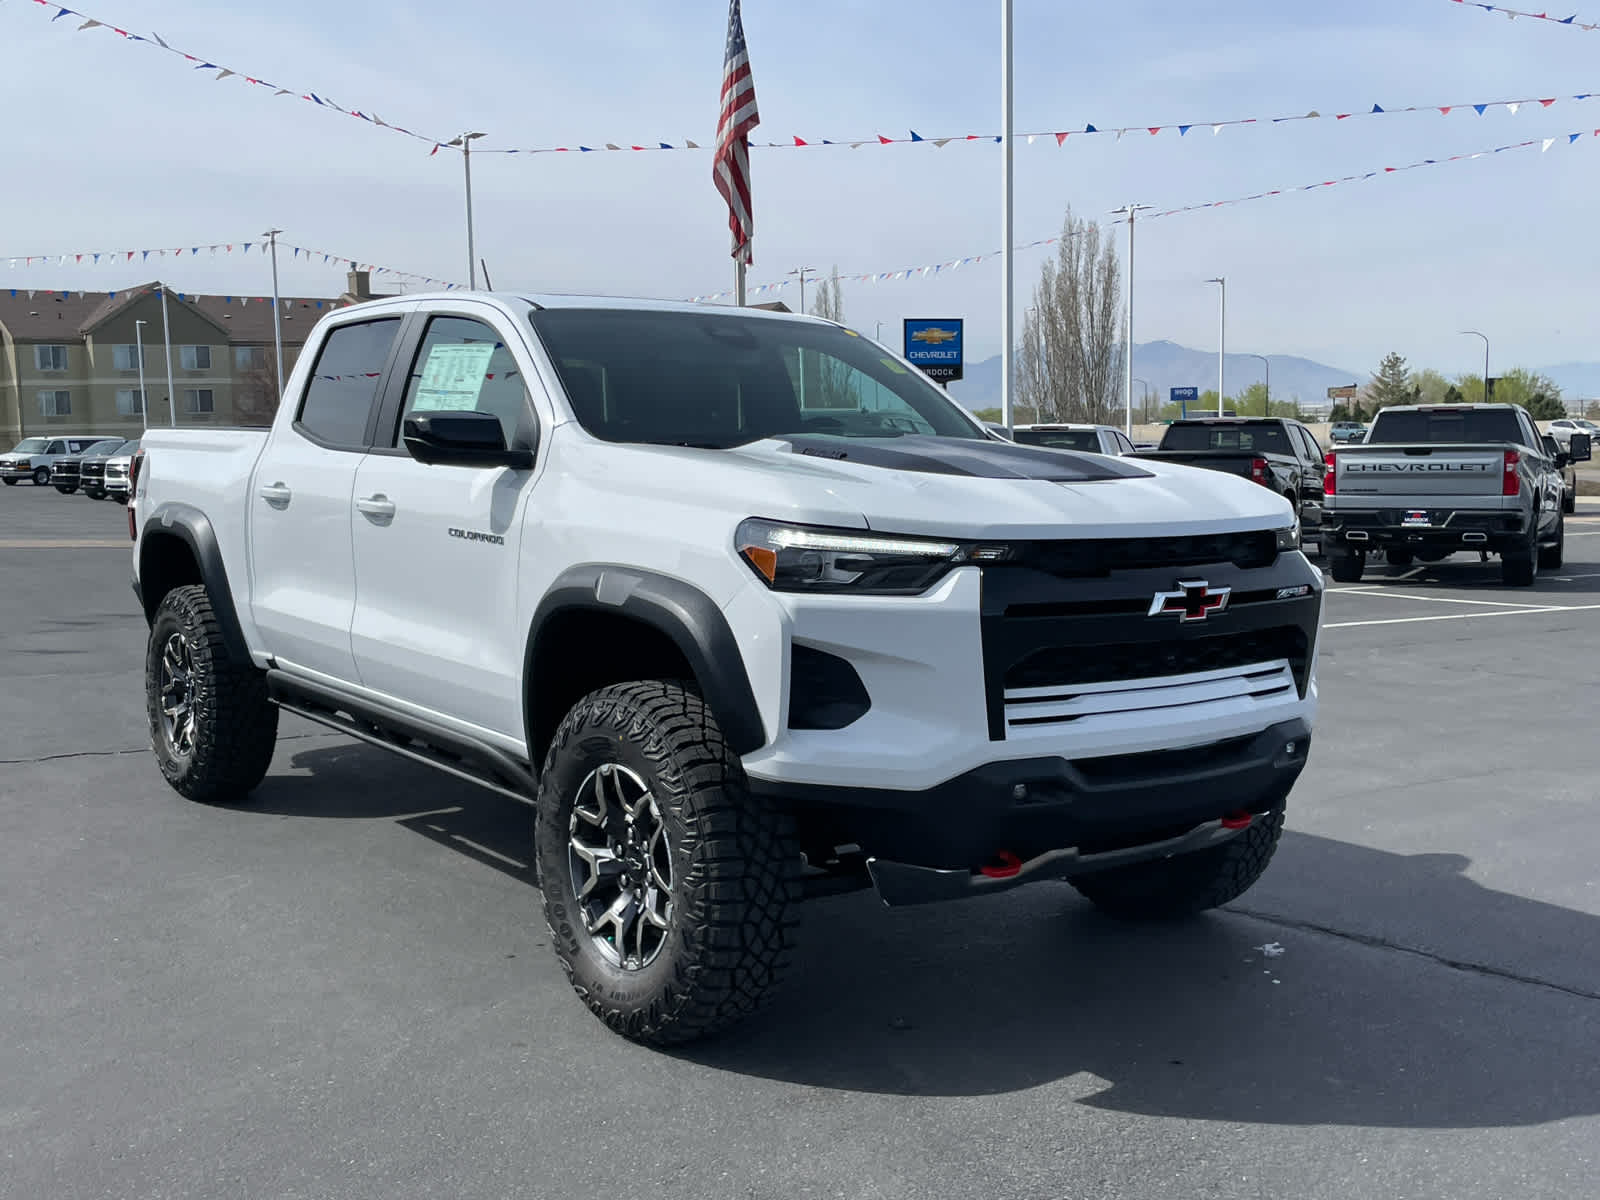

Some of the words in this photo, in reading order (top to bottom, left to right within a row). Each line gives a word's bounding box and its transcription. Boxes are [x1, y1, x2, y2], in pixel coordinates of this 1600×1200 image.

[909, 351, 958, 359] CHEVROLET
[920, 368, 954, 376] RDOCK
[1346, 463, 1491, 473] CHEVROLET
[448, 527, 505, 546] COLORADO
